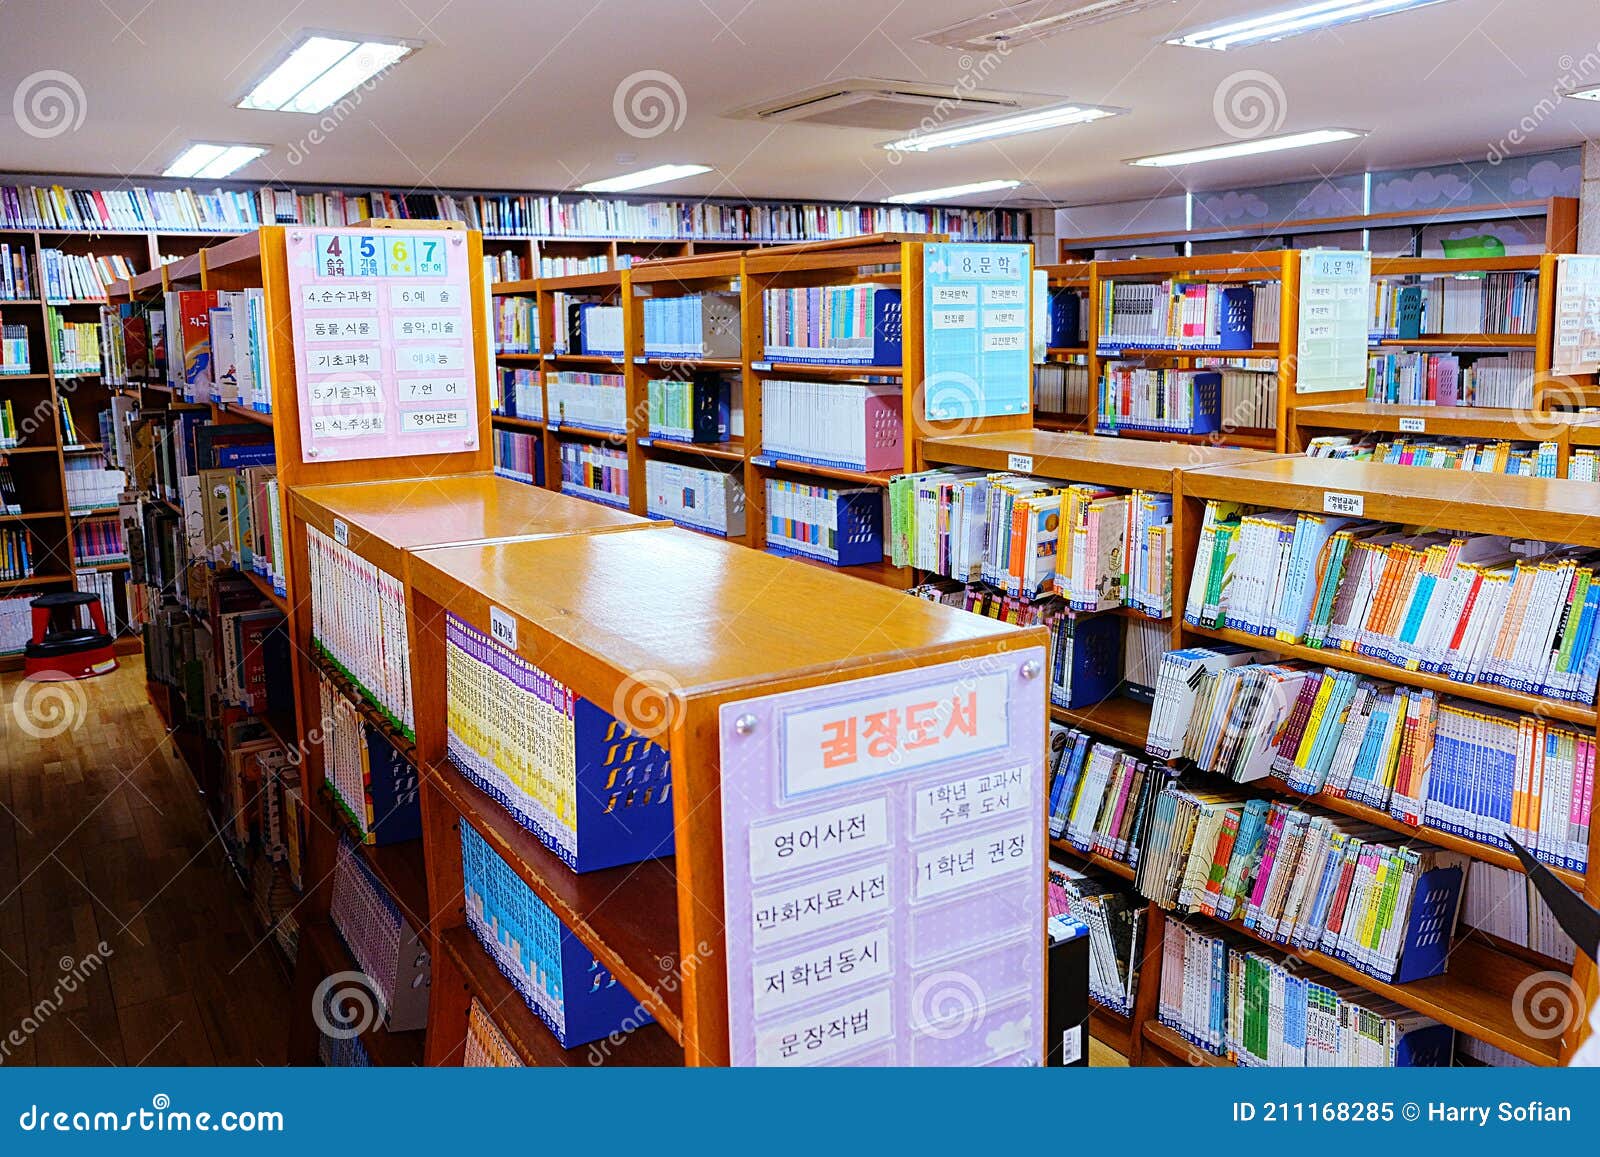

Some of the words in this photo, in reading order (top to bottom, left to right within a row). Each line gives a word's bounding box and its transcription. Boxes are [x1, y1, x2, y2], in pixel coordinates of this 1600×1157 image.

[327, 236, 342, 257] 4
[360, 236, 376, 257] 5
[393, 241, 408, 261] 6
[423, 242, 436, 262] 7
[308, 290, 372, 302] 4.순수과학
[940, 290, 968, 300] 한국문학
[314, 322, 370, 336] 동물,식물
[402, 322, 454, 334] 음악,미술
[318, 354, 370, 366] 기초과학
[314, 385, 377, 400] 5.기술과학
[412, 411, 458, 426] 영어관련
[820, 691, 978, 768] 권장도서
[928, 782, 967, 806] 1학년
[976, 768, 1023, 794] 교과서
[940, 802, 971, 826] 수록
[980, 792, 1010, 814] 도서
[774, 814, 867, 858] 영어사전
[924, 848, 975, 880] 1학년
[988, 834, 1026, 864] 권장
[756, 874, 887, 930] 만화자료사전
[765, 940, 879, 994] 저학년동시
[778, 1008, 870, 1059] 문장작법
